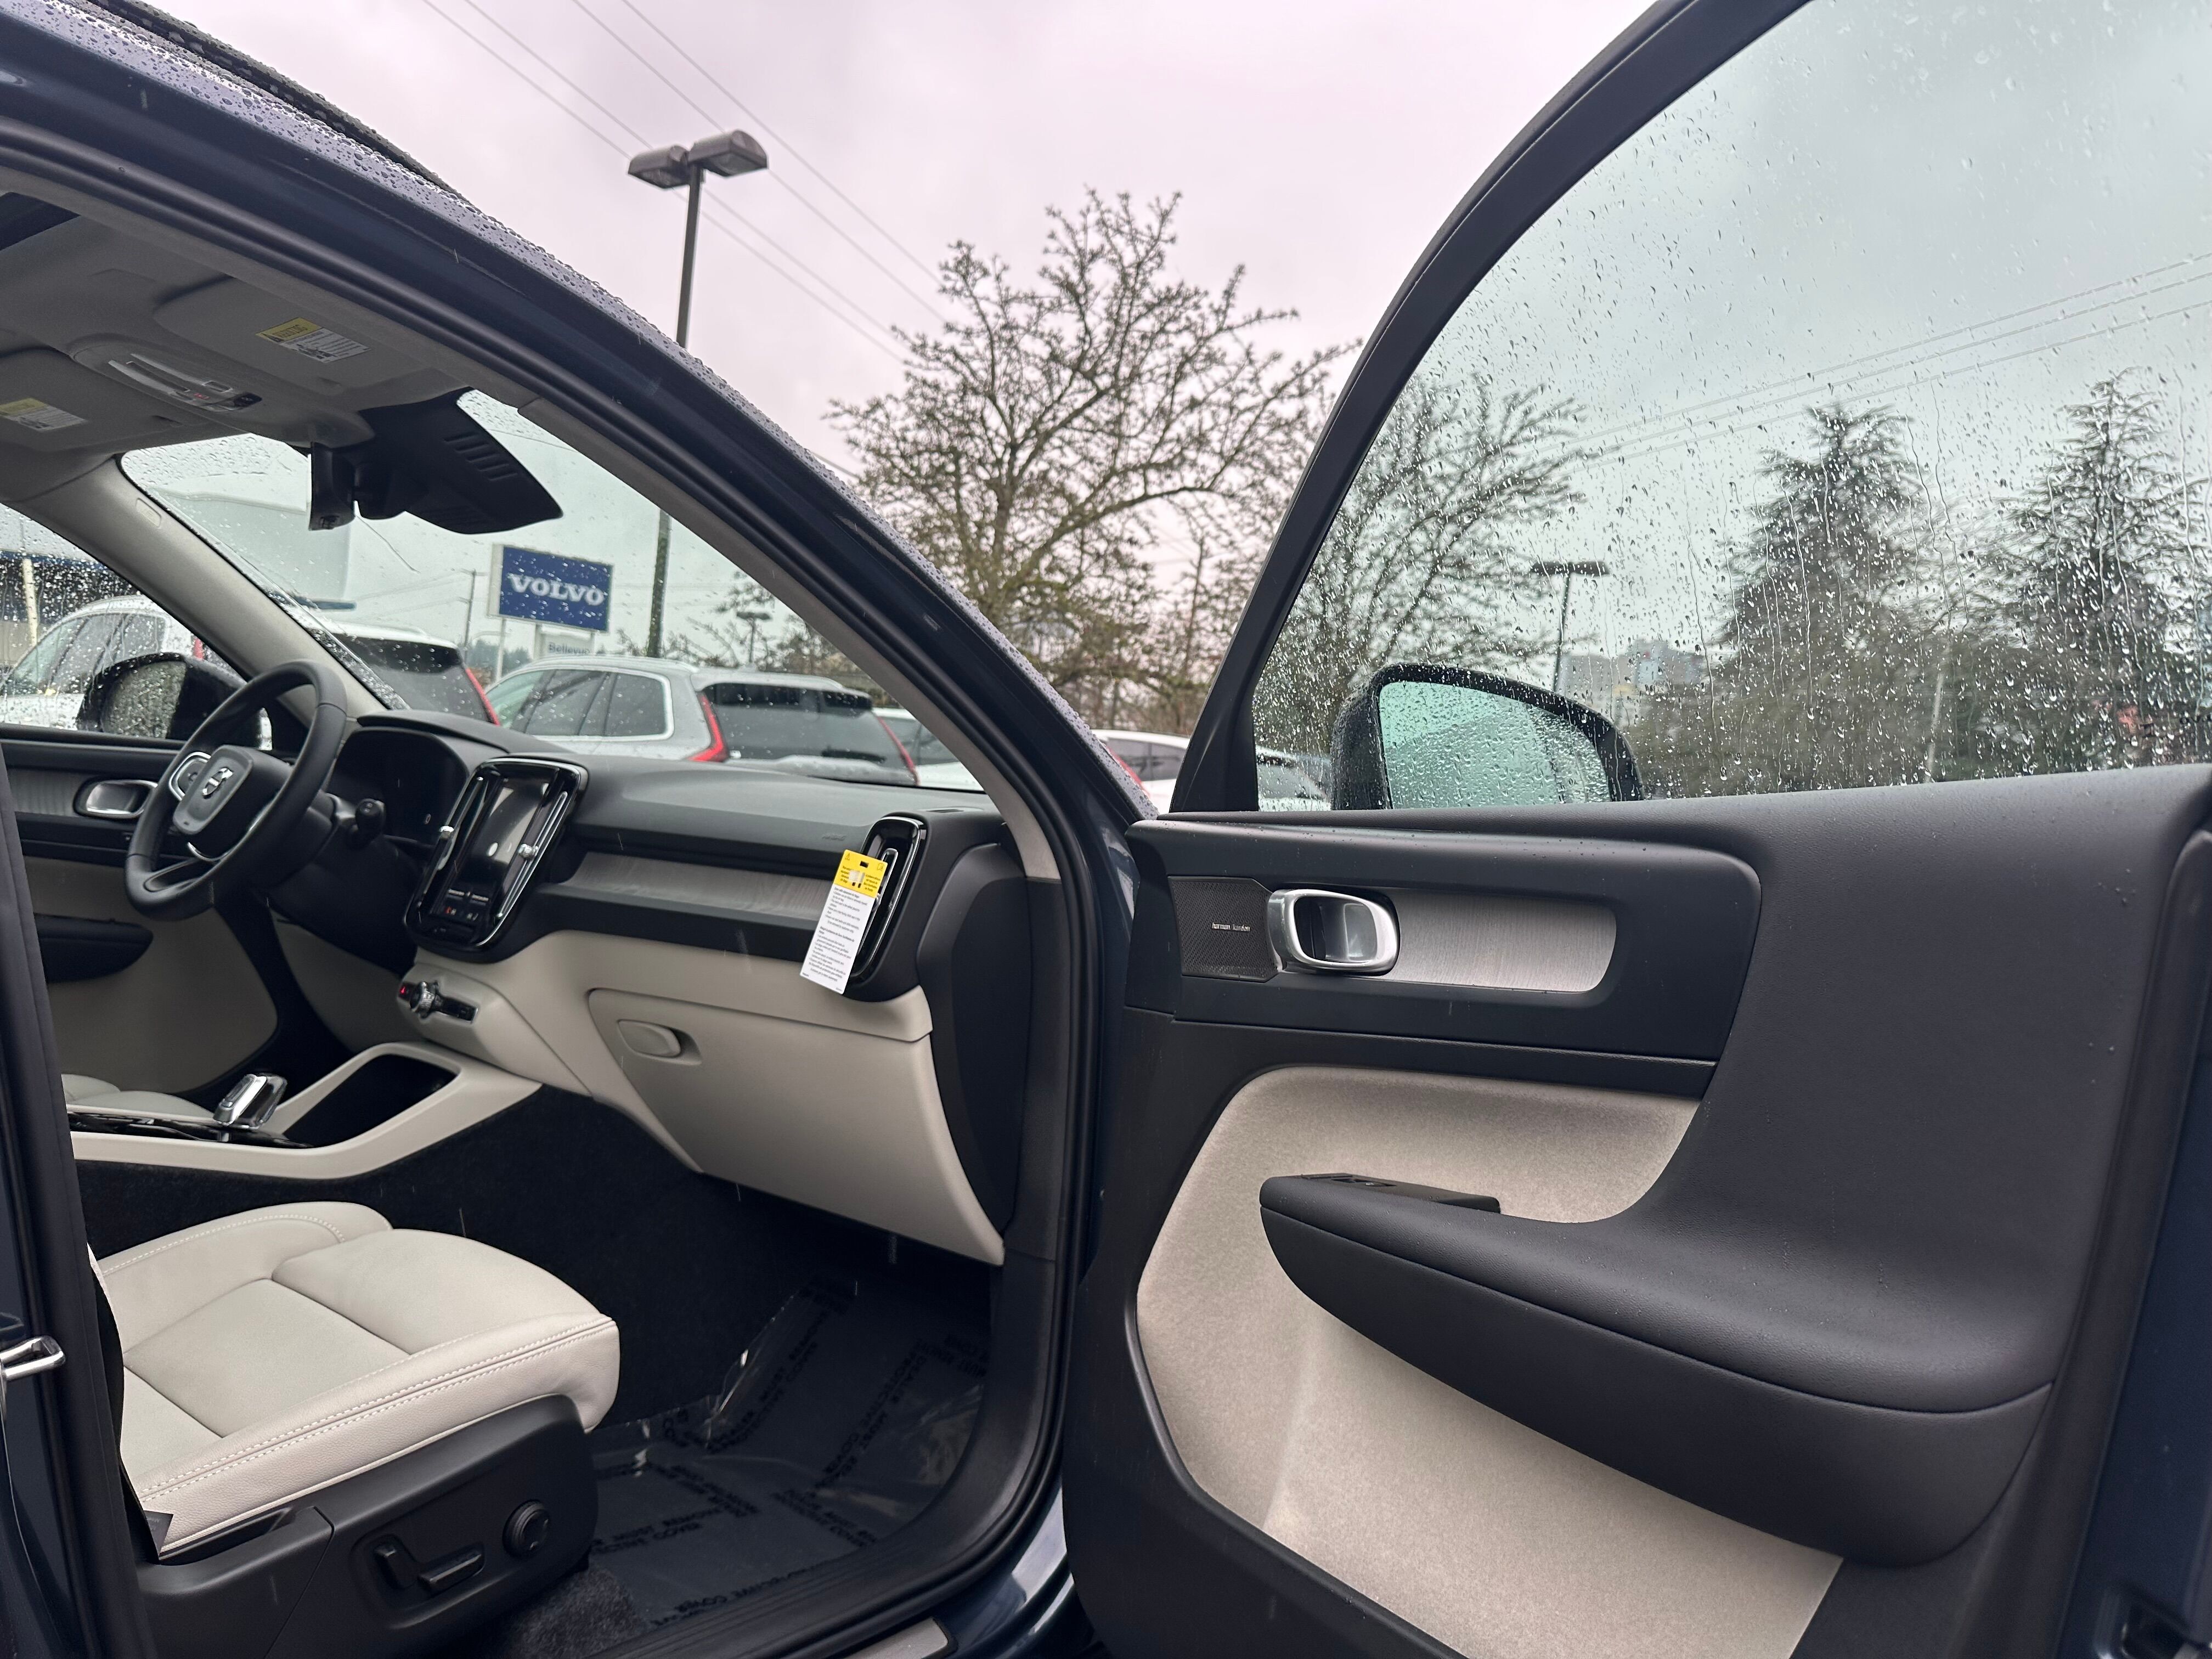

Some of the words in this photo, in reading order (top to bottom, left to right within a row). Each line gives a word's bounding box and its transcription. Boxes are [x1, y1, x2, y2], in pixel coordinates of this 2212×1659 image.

[508, 573, 604, 606] VOLVO
[549, 642, 590, 654] Bellevue
[653, 1522, 702, 1541] COVER
